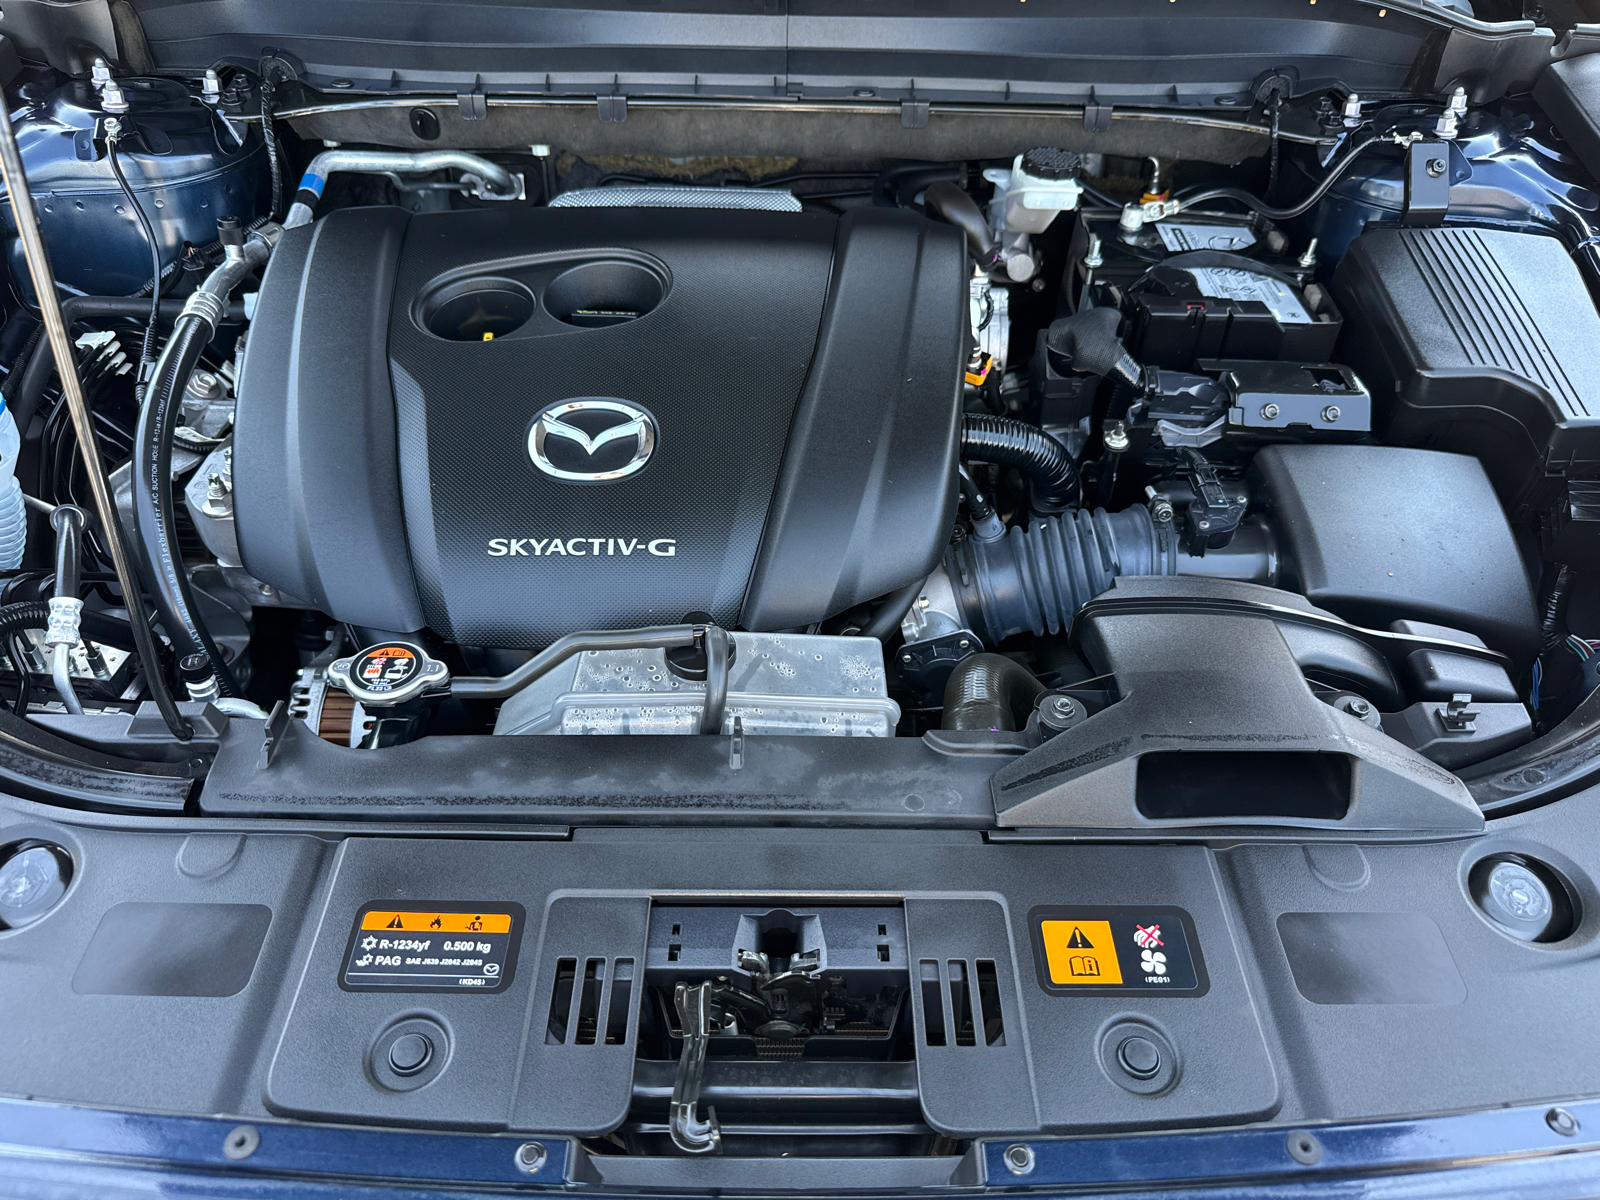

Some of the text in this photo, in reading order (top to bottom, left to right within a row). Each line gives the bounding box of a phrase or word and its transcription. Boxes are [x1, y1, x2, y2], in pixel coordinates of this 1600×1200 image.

[151, 463, 159, 491] SUCTION
[154, 507, 171, 563] Flexbarrier
[487, 537, 677, 557] SKYACTIV-G
[379, 939, 492, 954] R-1234yf 0.500 kg
[374, 955, 402, 966] PAG
[405, 957, 422, 965] SAE
[422, 957, 439, 965] J639
